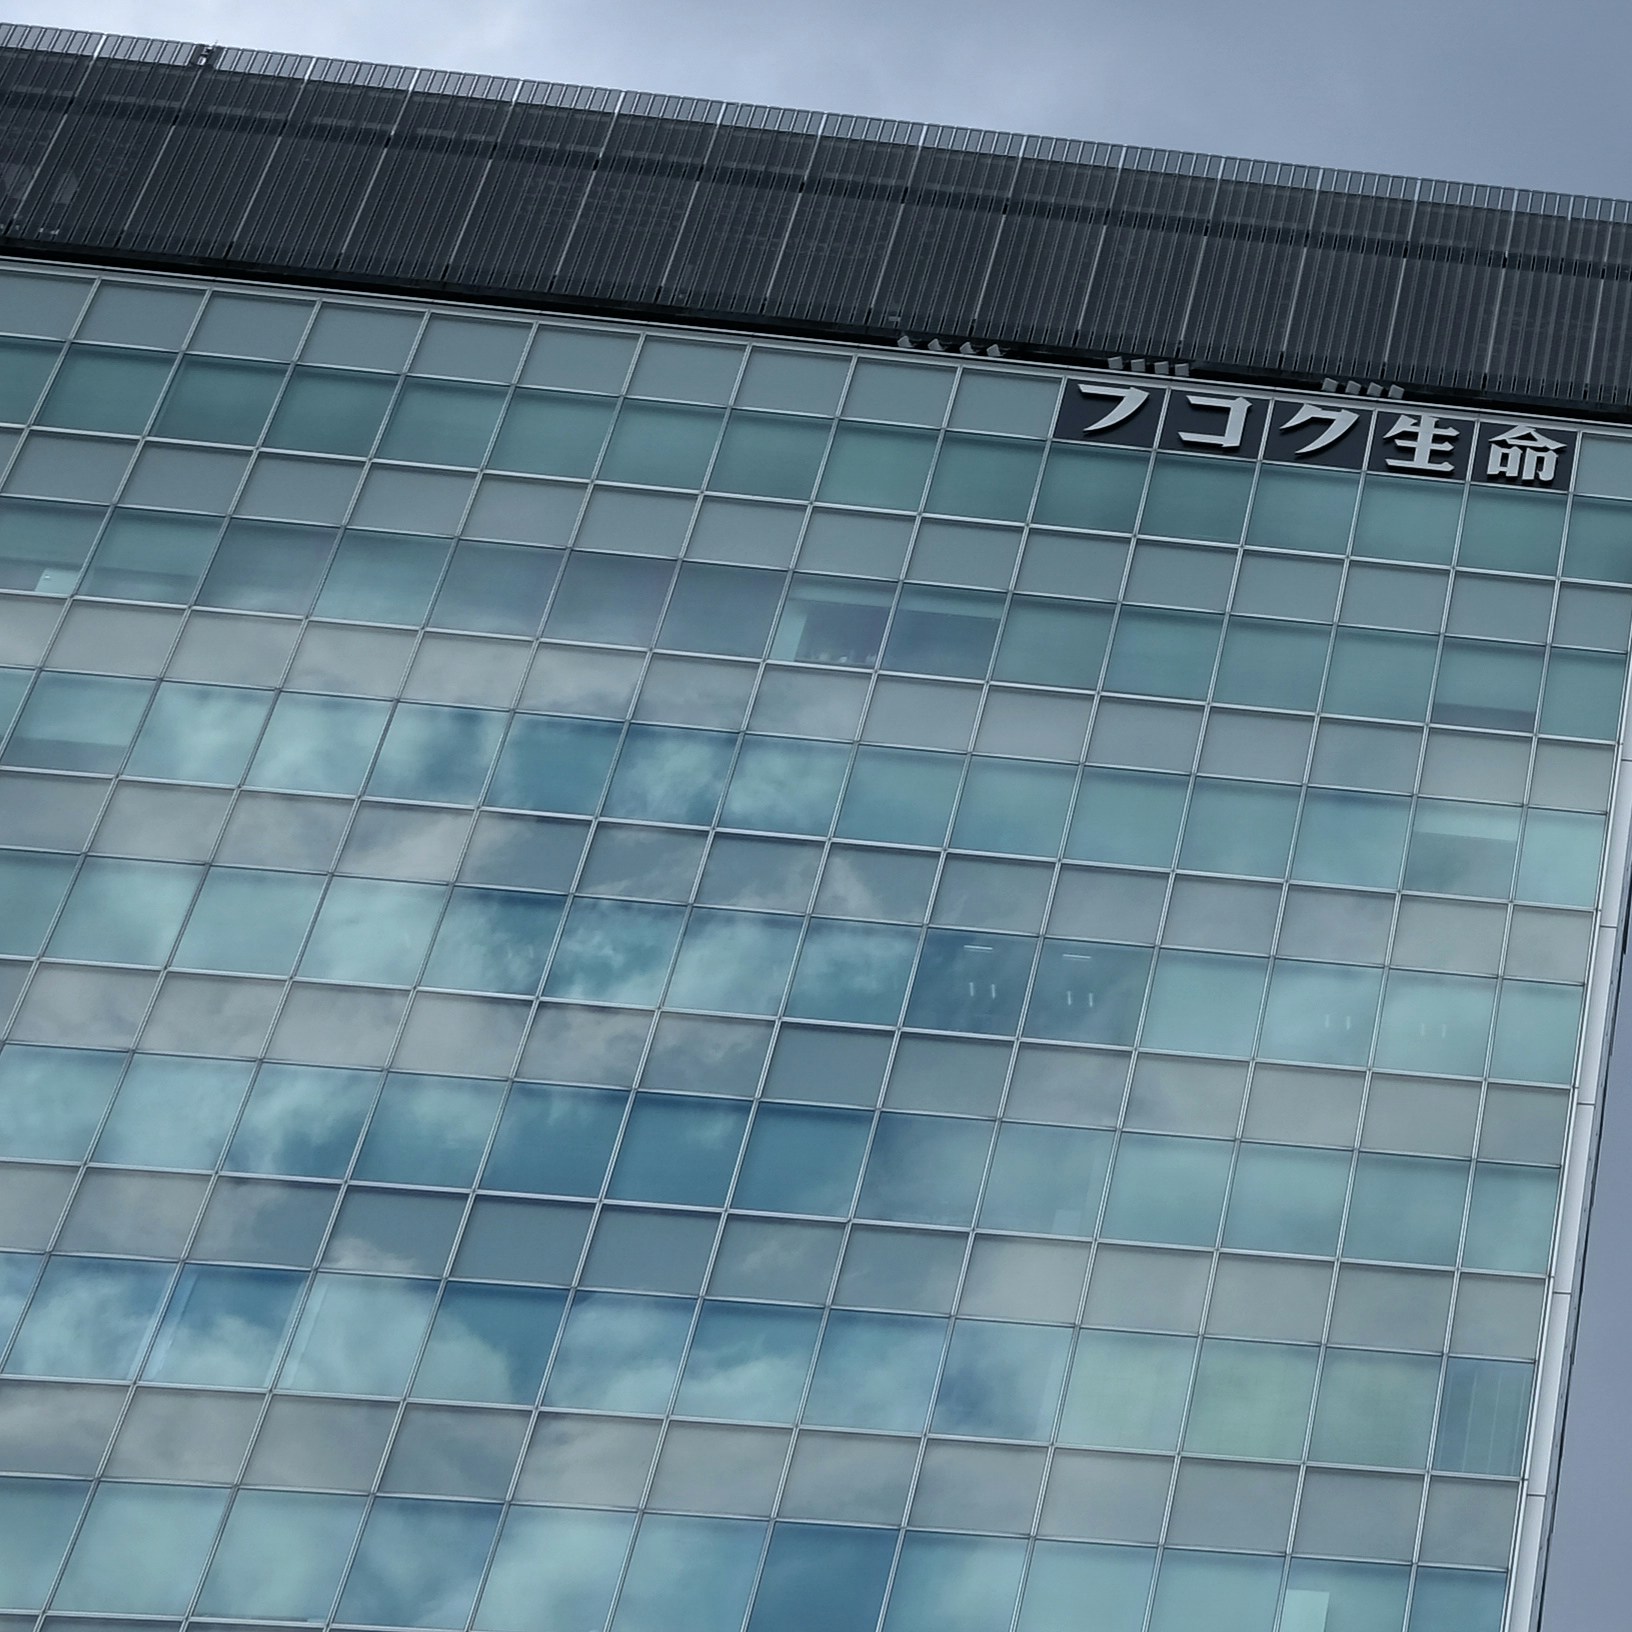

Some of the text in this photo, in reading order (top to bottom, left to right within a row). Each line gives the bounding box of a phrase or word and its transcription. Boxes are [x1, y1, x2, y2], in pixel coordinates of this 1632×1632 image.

[1077, 382, 1567, 485] フコク生命
